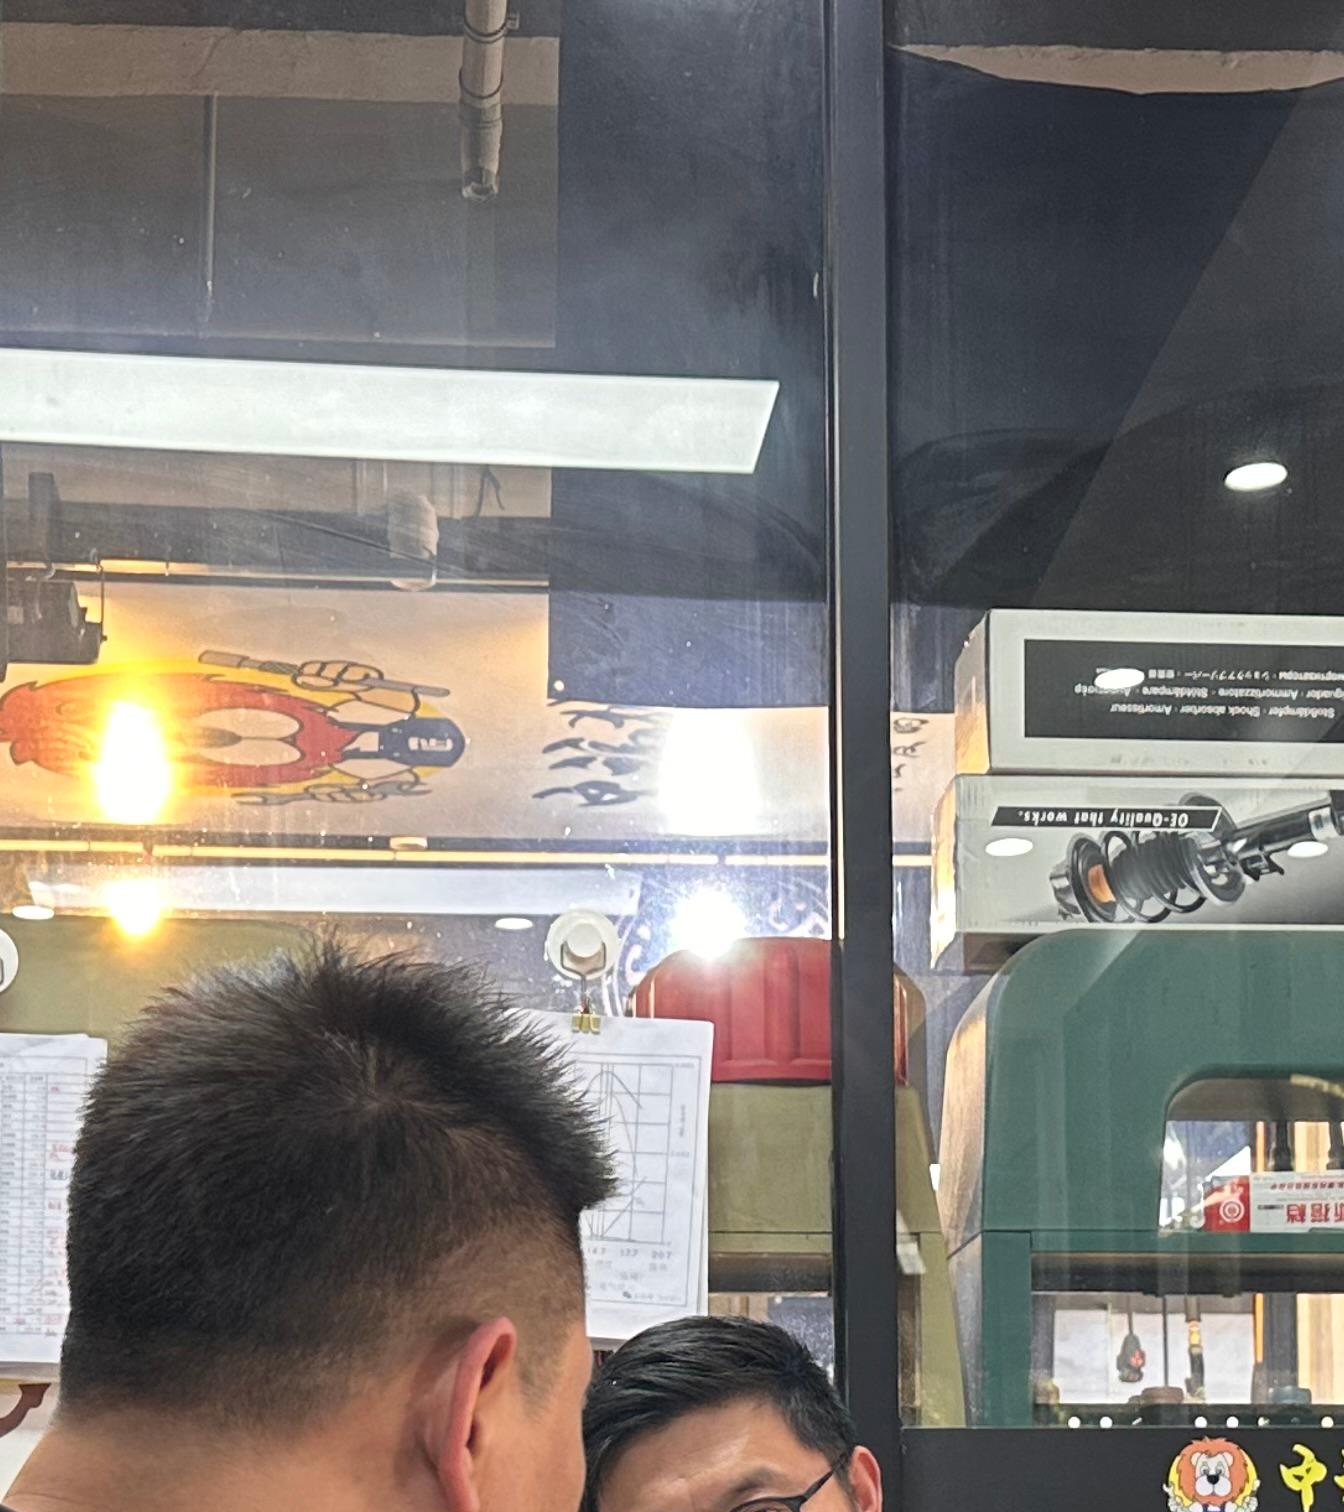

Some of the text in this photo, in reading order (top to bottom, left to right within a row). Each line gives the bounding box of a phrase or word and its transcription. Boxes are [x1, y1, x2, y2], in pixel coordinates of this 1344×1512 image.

[1018, 809, 1189, 828] OE-Quality that works.
